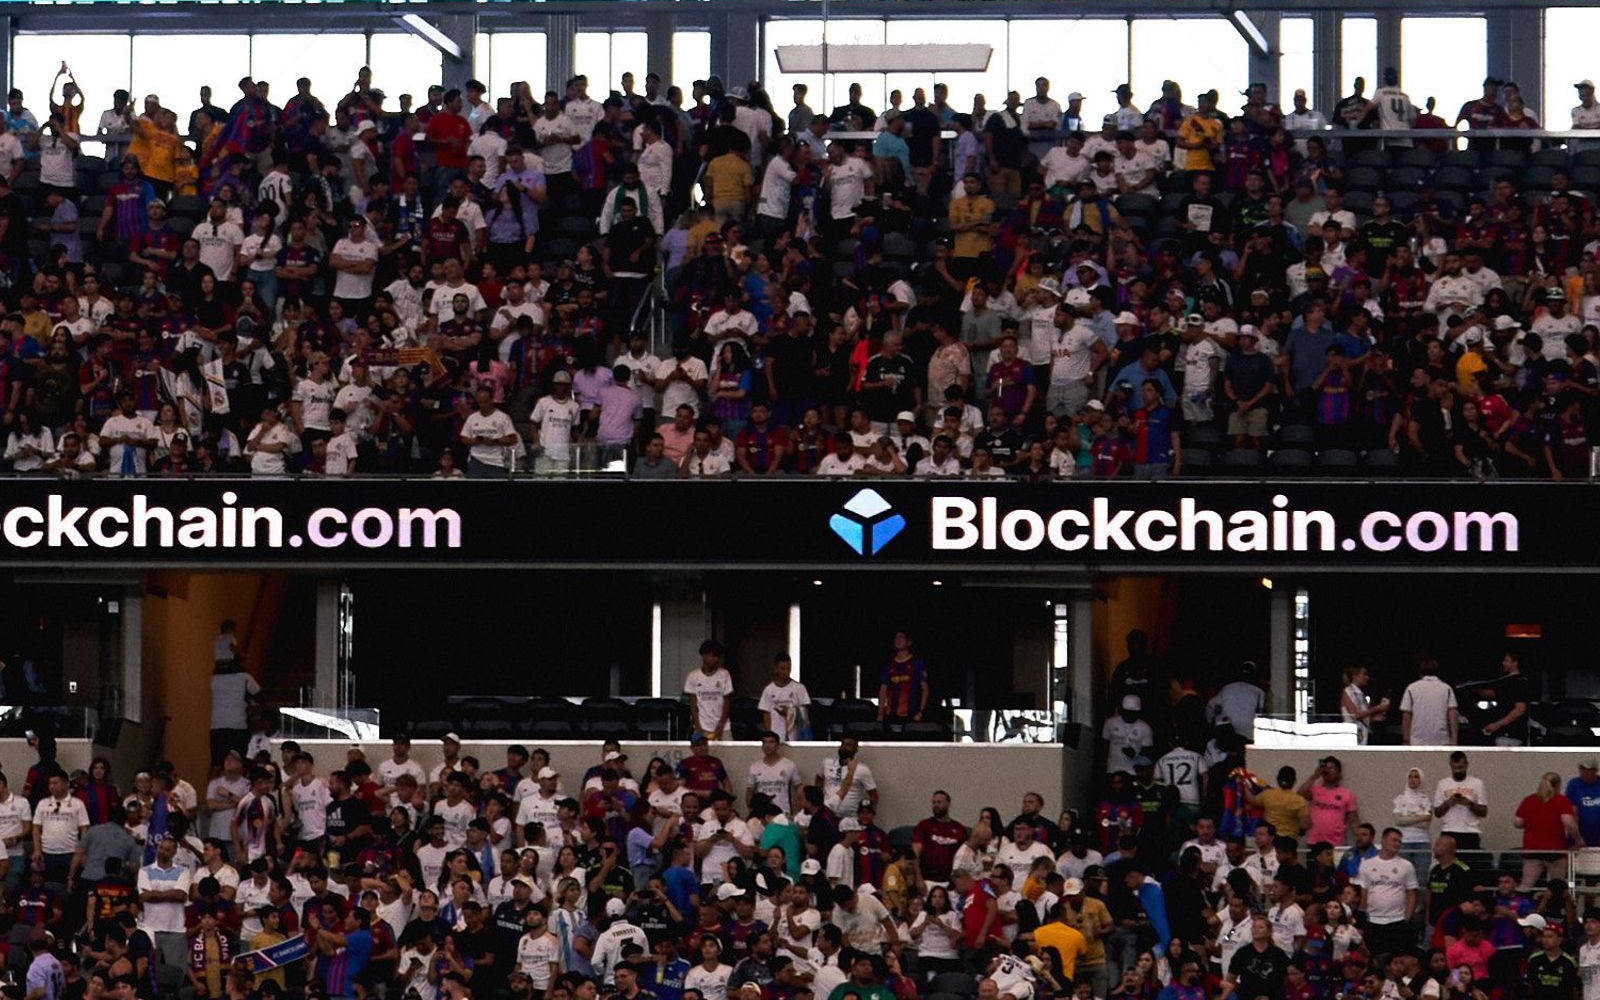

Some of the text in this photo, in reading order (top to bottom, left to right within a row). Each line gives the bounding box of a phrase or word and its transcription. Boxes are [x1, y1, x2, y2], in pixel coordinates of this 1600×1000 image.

[1391, 98, 1405, 117] 4
[931, 494, 1519, 552] Blockchain.com
[1168, 762, 1191, 785] 12
